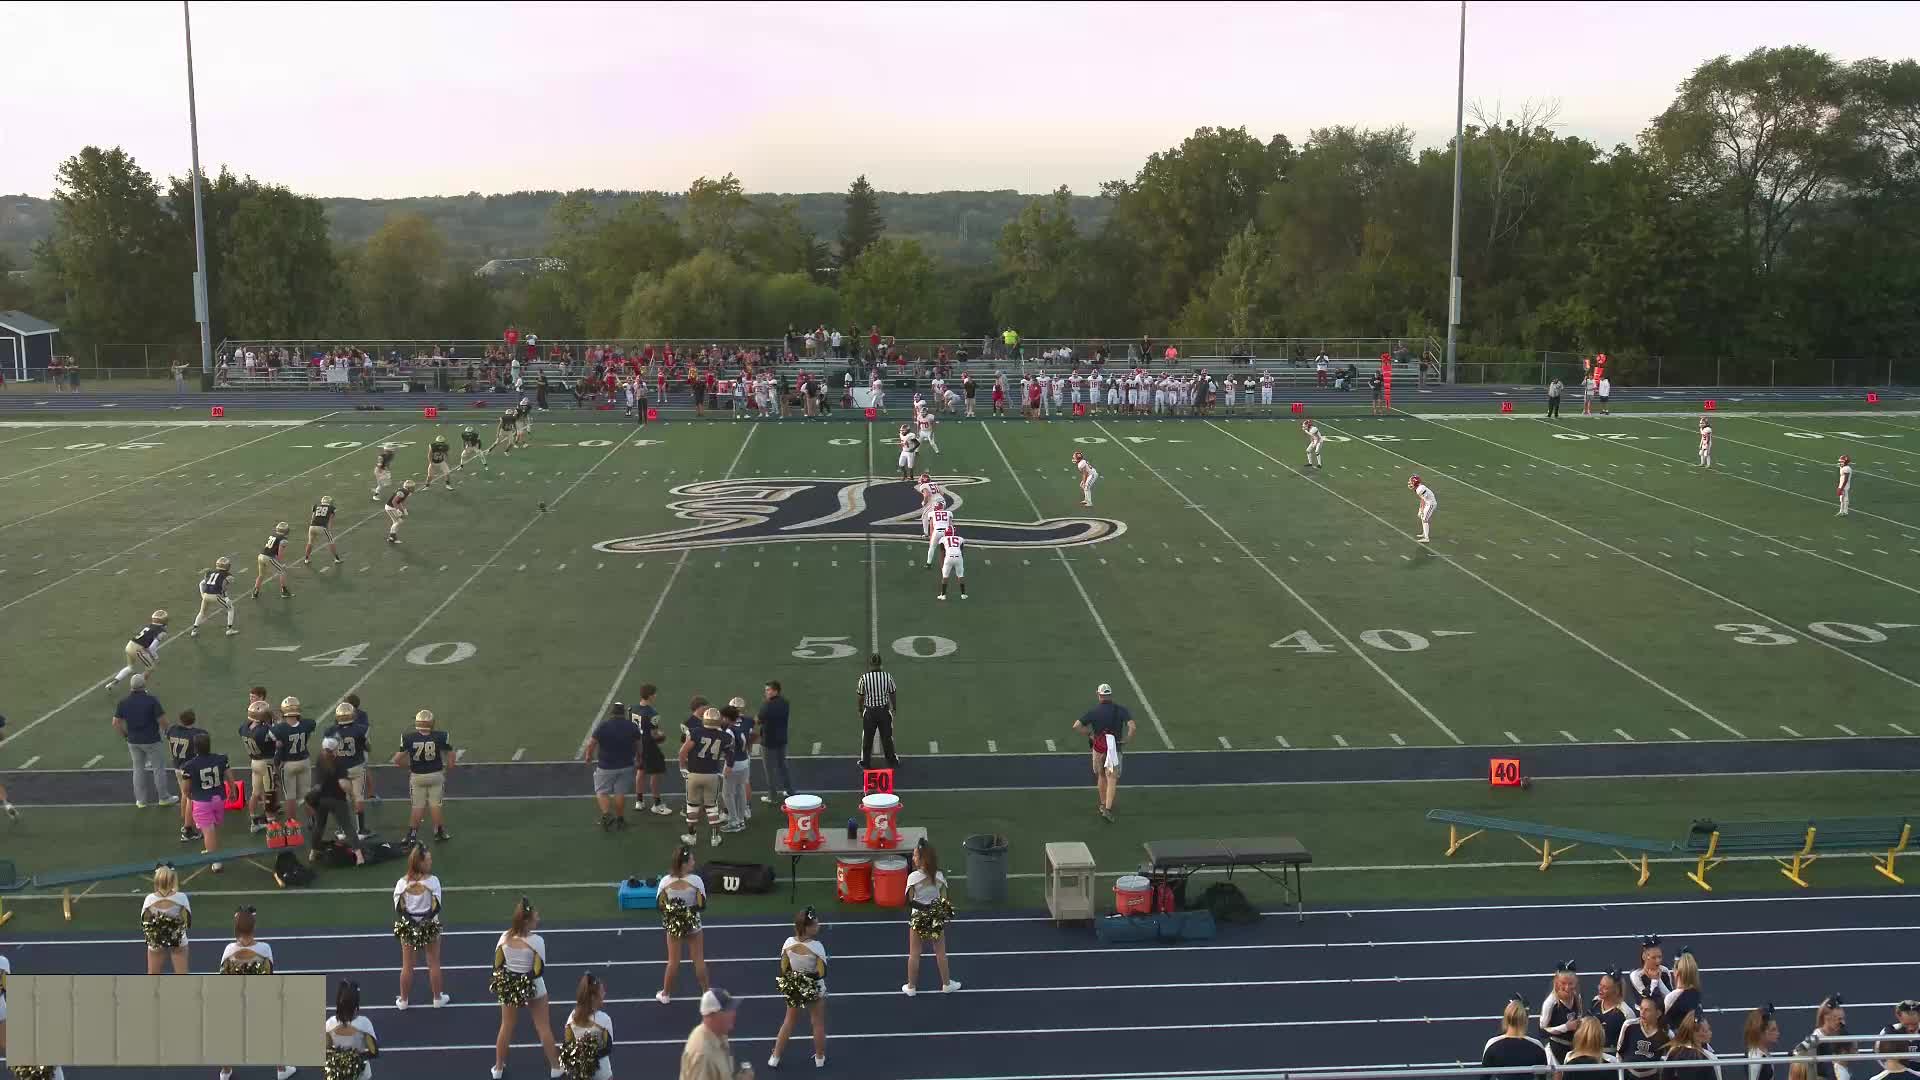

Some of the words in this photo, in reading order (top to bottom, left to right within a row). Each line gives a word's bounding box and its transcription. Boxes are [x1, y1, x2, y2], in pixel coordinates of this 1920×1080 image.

[947, 536, 960, 548] 15
[206, 572, 220, 585] 11
[791, 635, 958, 660] 50
[169, 738, 190, 759] 77
[288, 733, 307, 755] 71
[412, 742, 436, 761] 78
[697, 737, 721, 760] 74
[199, 765, 221, 790] 51
[867, 772, 890, 792] 50
[1495, 762, 1517, 782] 40
[797, 815, 811, 831] G
[874, 815, 889, 831] G
